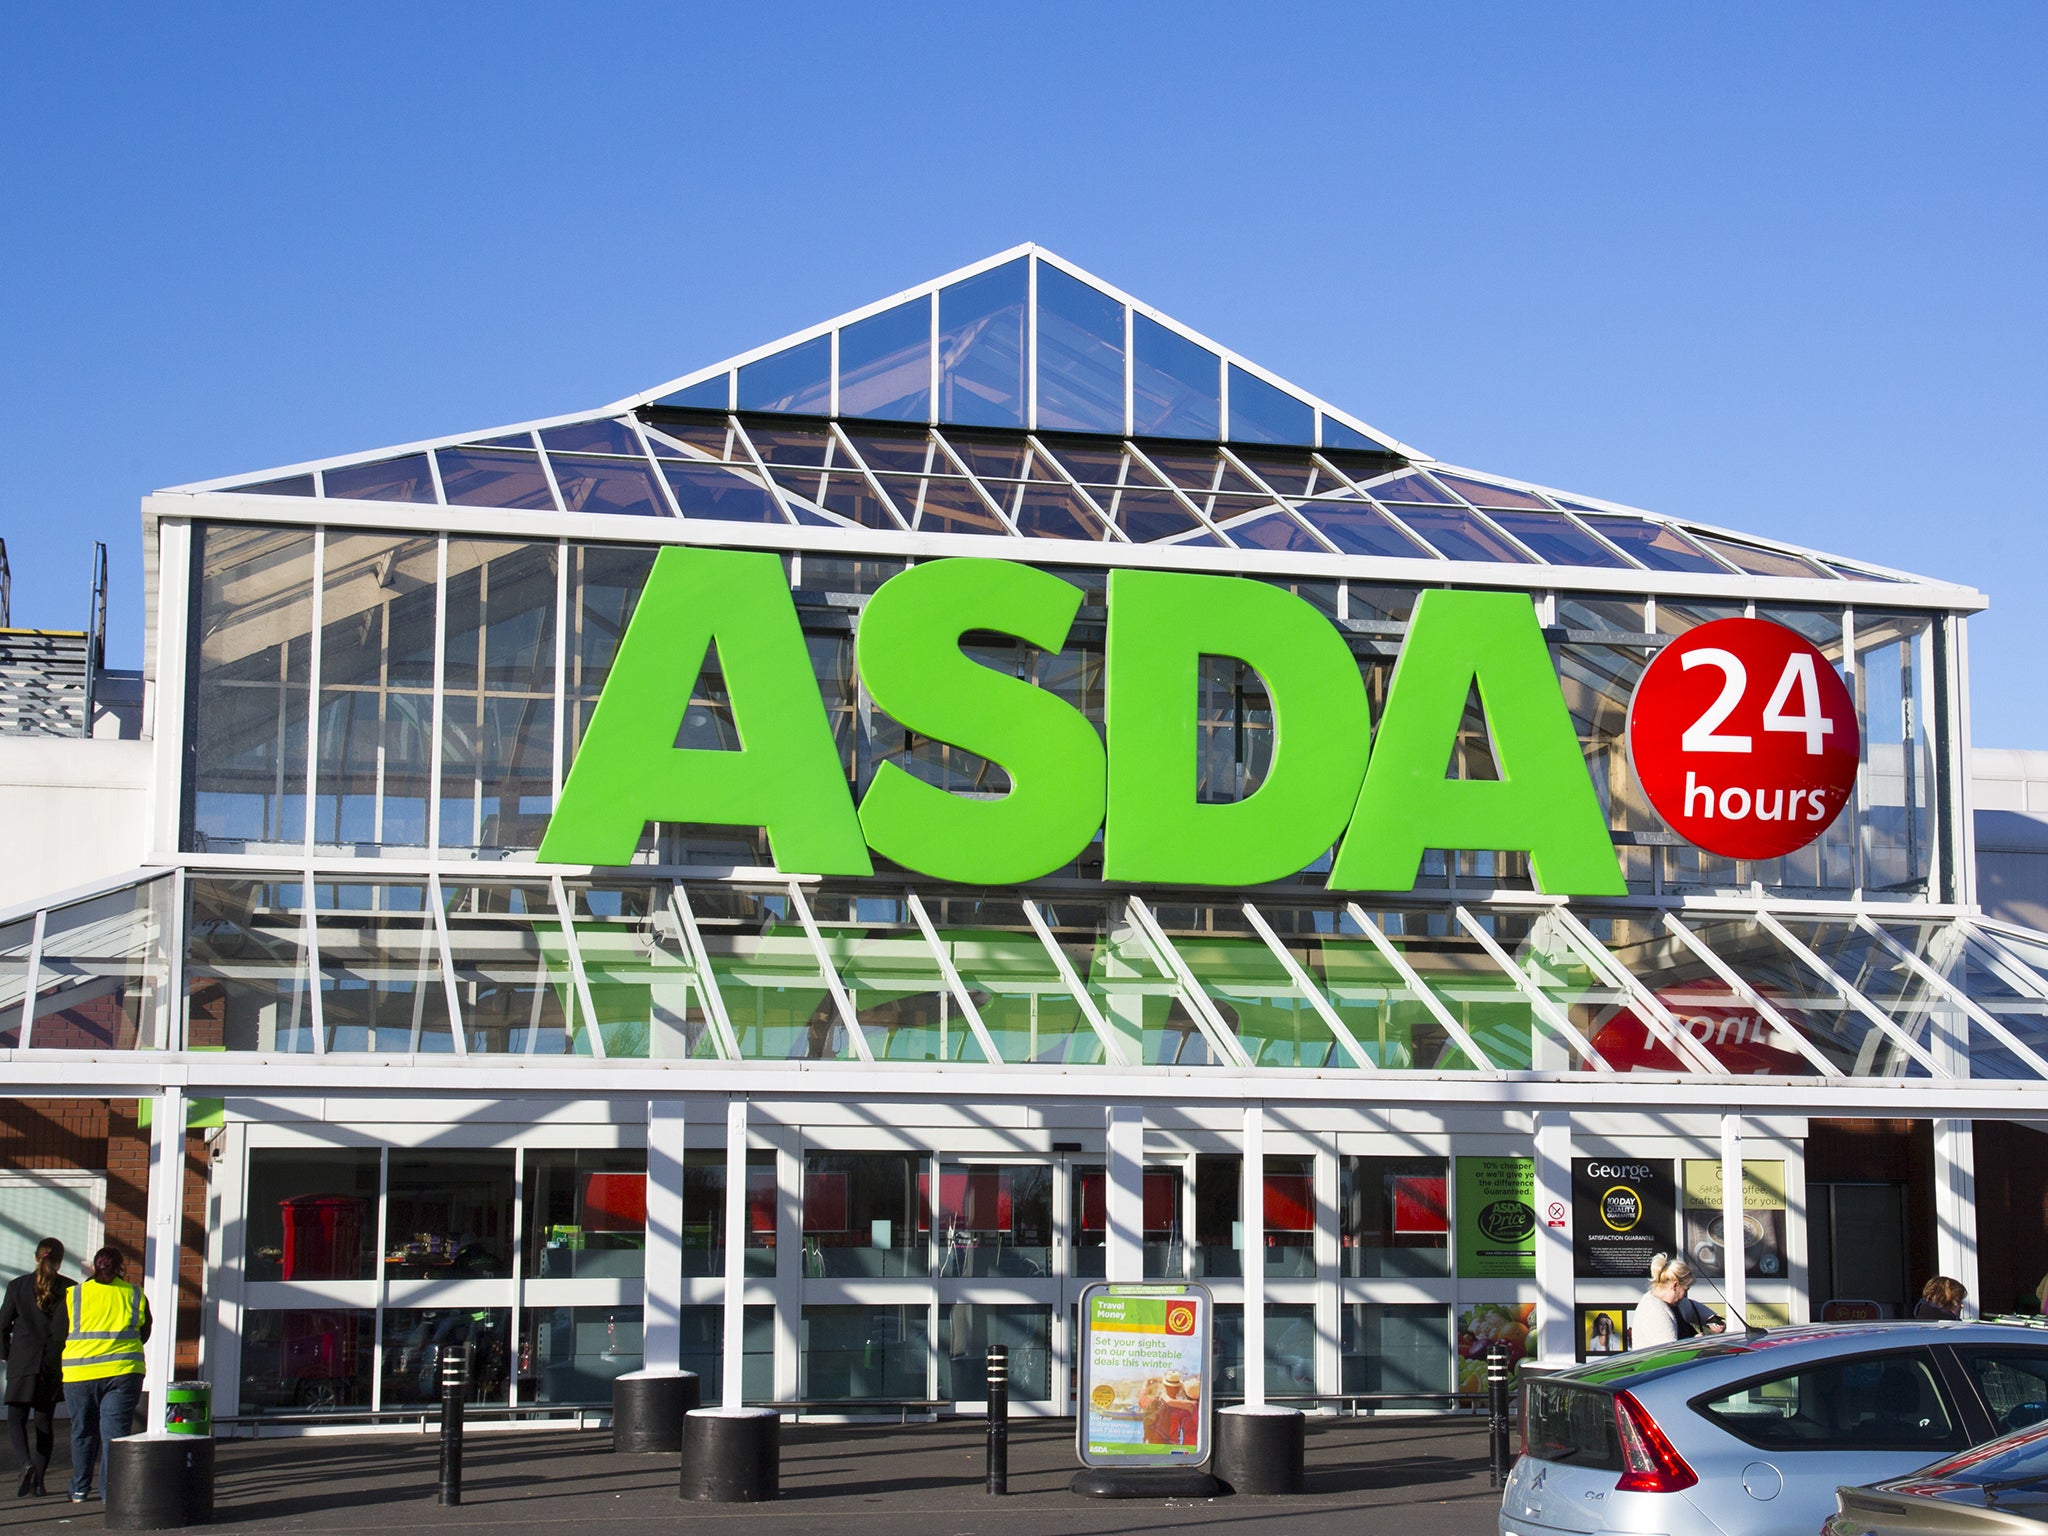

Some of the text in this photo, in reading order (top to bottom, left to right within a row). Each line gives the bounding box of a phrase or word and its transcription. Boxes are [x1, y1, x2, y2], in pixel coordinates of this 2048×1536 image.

[1681, 648, 1833, 756] 24
[535, 545, 1628, 897] ASDA
[1684, 771, 1826, 821] hours
[1500, 1162, 1532, 1172] cheaper
[1506, 1171, 1523, 1179] give
[1587, 1162, 1653, 1183] George.
[1483, 1187, 1532, 1195] Guaranteed.
[1742, 1185, 1768, 1195] offee,
[1607, 1197, 1636, 1205] 100 DAY
[1744, 1197, 1757, 1205] for
[1492, 1203, 1523, 1213] ASDA
[1606, 1205, 1636, 1213] QUALITY
[1488, 1213, 1526, 1233] Price
[1097, 1301, 1125, 1310] Travel
[1096, 1310, 1126, 1320] Money
[1095, 1337, 1166, 1349] Set your sights
[1128, 1349, 1182, 1359] unbeatable
[1094, 1358, 1172, 1369] deals this winter
